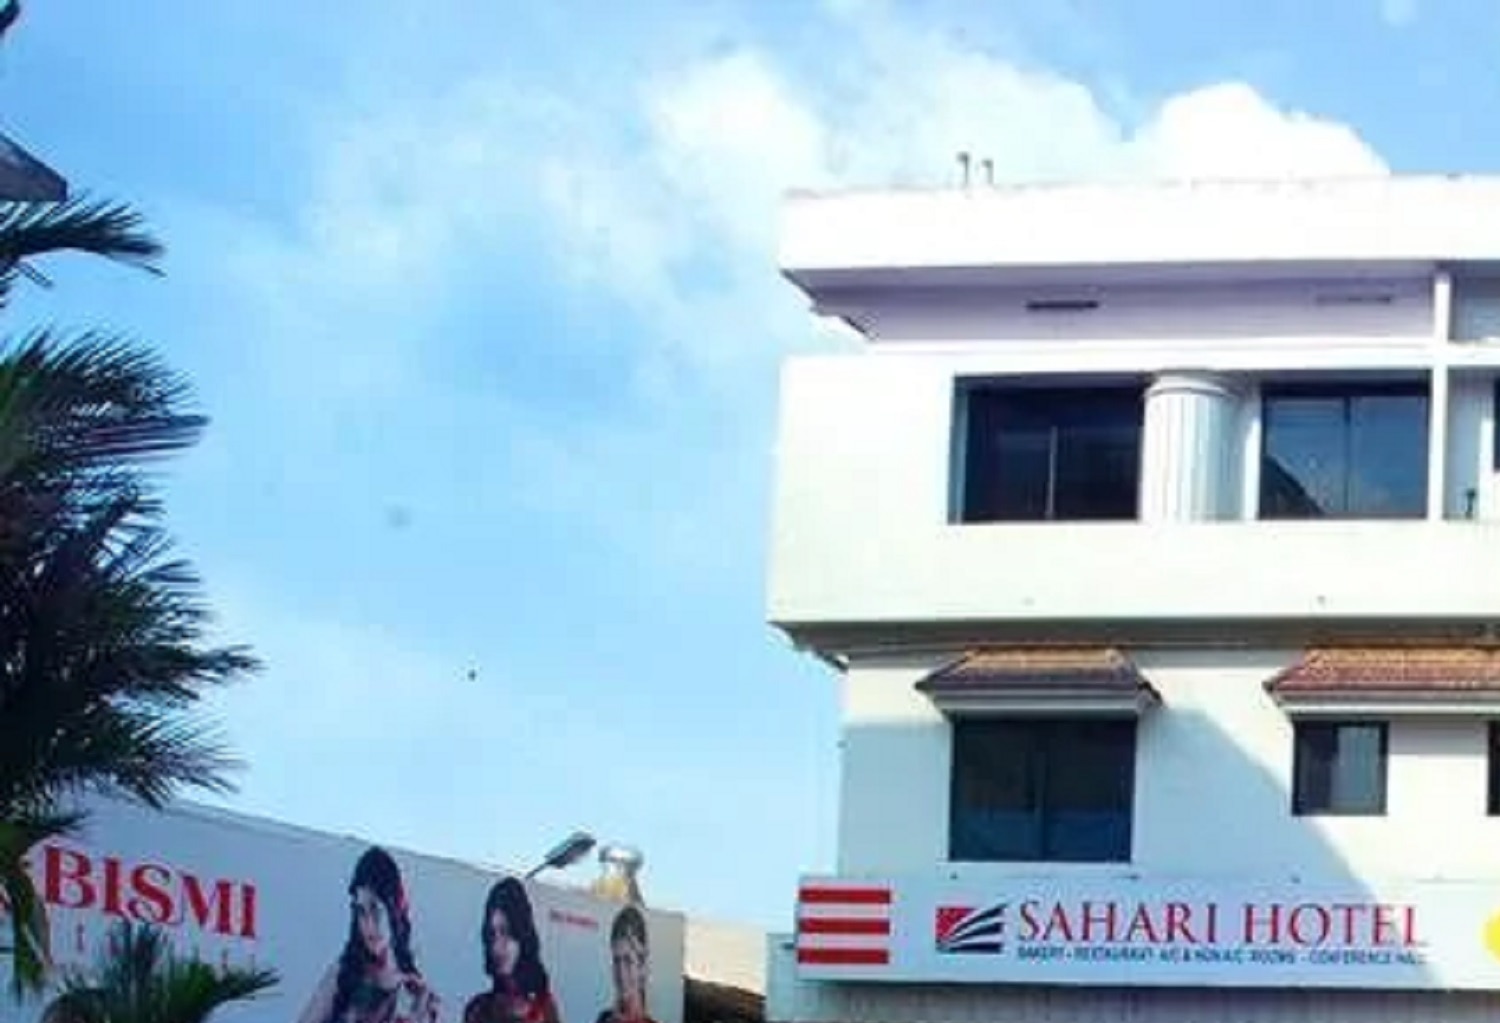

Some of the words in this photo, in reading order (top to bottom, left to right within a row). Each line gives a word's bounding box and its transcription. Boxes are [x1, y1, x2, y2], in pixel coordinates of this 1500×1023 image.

[44, 844, 256, 938] BISMI
[1018, 901, 1216, 943] SAHARI
[1243, 904, 1427, 946] HOTEL
